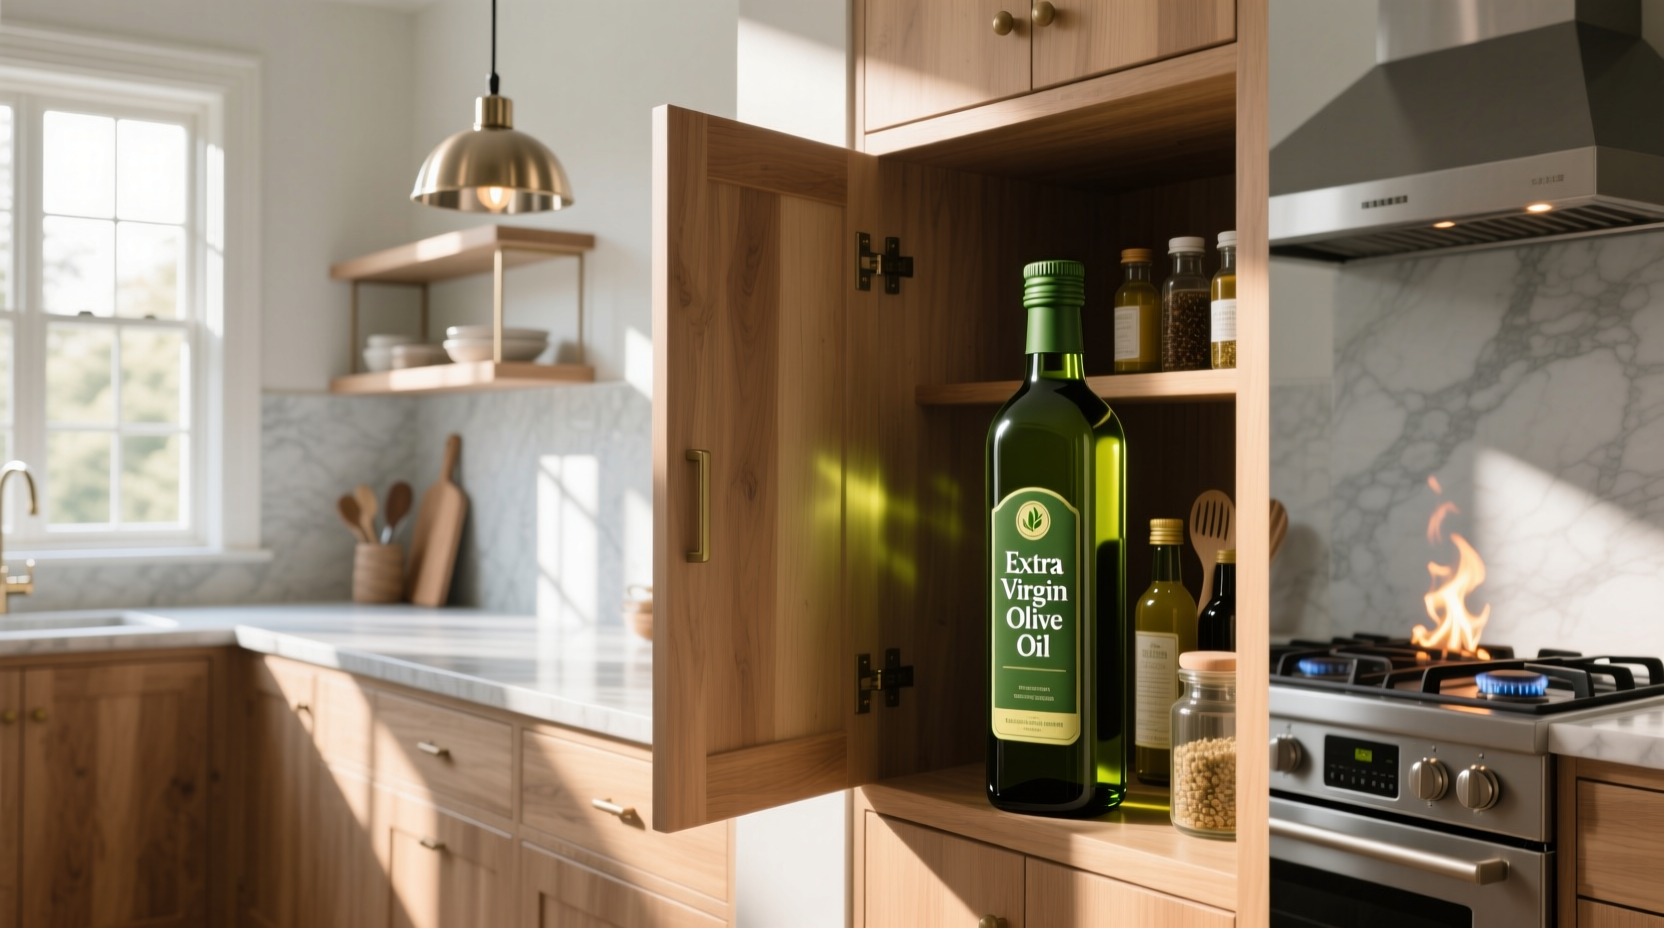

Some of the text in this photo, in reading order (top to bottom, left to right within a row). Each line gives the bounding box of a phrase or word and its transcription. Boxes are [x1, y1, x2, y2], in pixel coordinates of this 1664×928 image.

[1004, 550, 1065, 575] Extra
[1000, 577, 1069, 608] Virgin
[1006, 605, 1063, 631] Olive
[1016, 633, 1050, 658] Oil
